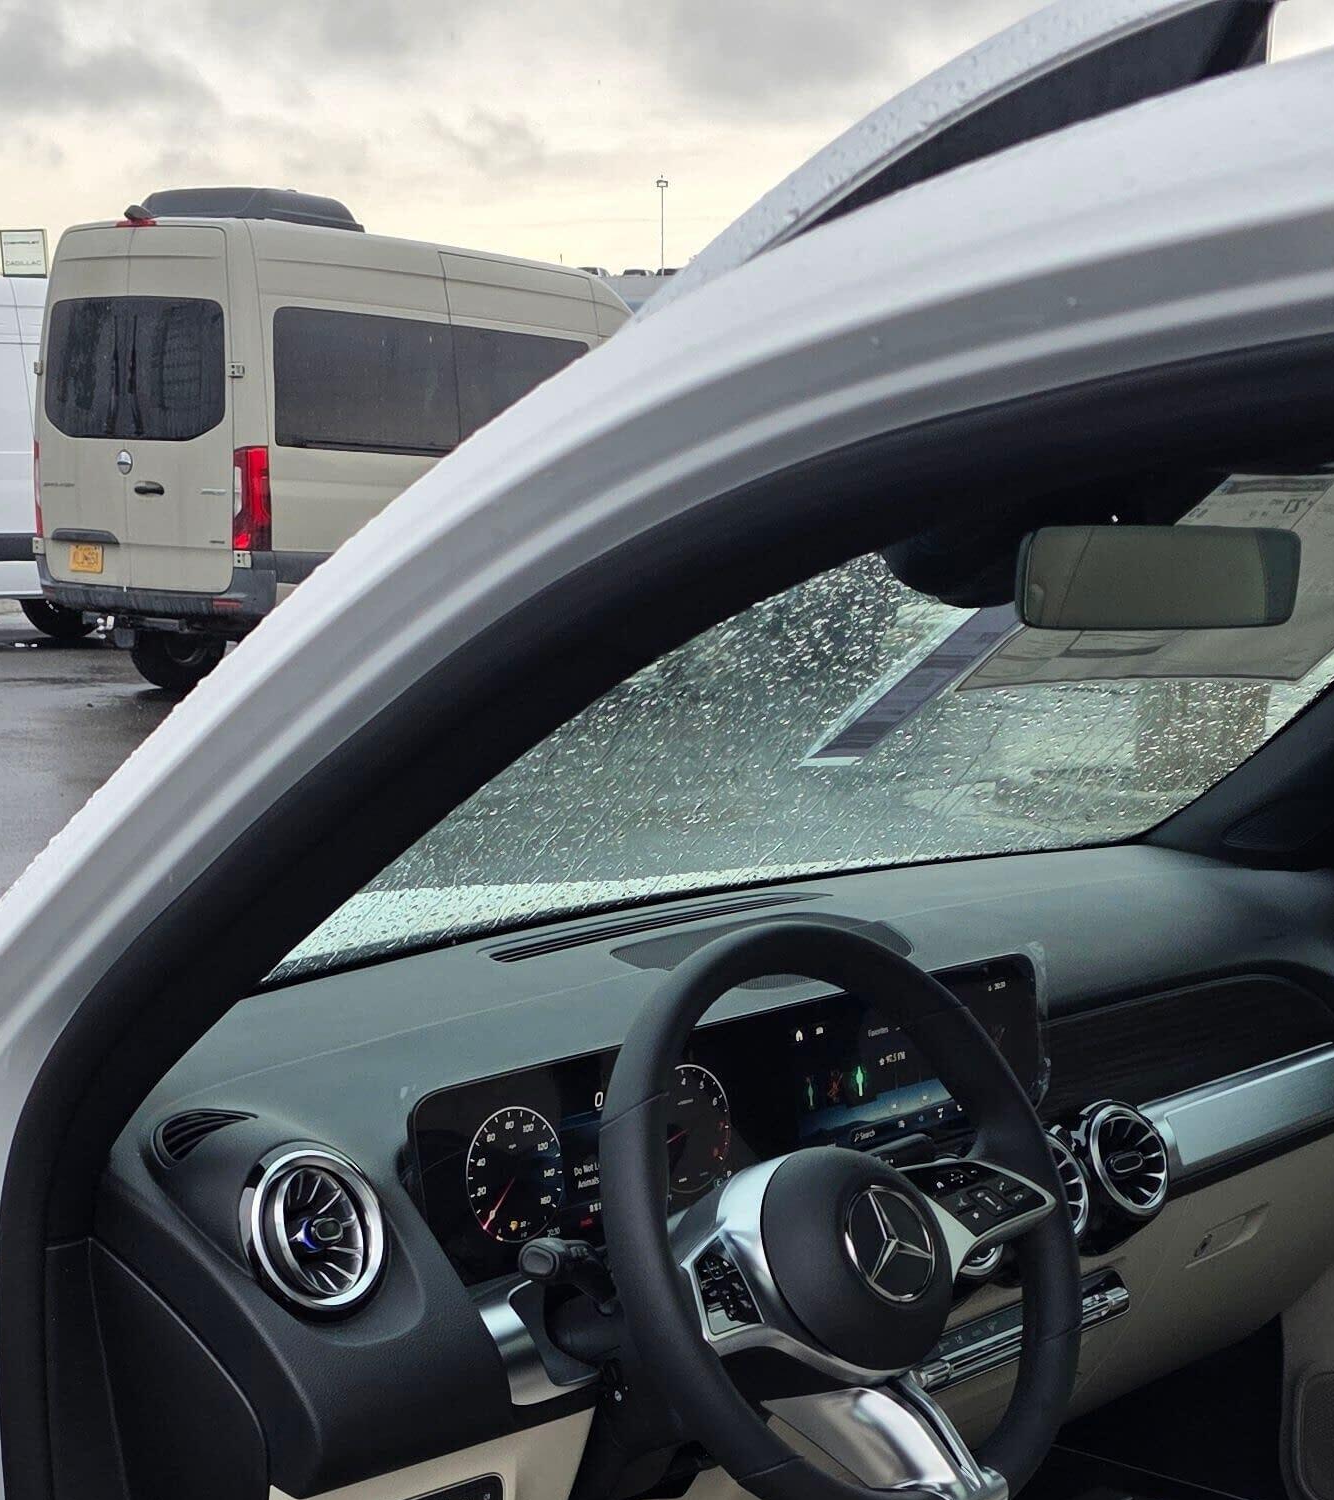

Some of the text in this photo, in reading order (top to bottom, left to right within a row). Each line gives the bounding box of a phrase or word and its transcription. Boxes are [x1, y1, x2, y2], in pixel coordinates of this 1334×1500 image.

[681, 1077, 687, 1086] 4
[699, 1080, 705, 1089] 5
[594, 1091, 604, 1108] 0
[712, 1097, 718, 1106] 6
[505, 1121, 515, 1130] 80
[522, 1123, 534, 1133] 100
[859, 1129, 876, 1140] Search
[537, 1141, 548, 1151] 120
[476, 1157, 486, 1167] 40
[543, 1168, 555, 1178] 140
[573, 1166, 583, 1177] Do
[583, 1163, 594, 1174] Not
[577, 1176, 600, 1189] Animals
[477, 1186, 487, 1196] 20
[540, 1195, 551, 1205] 160
